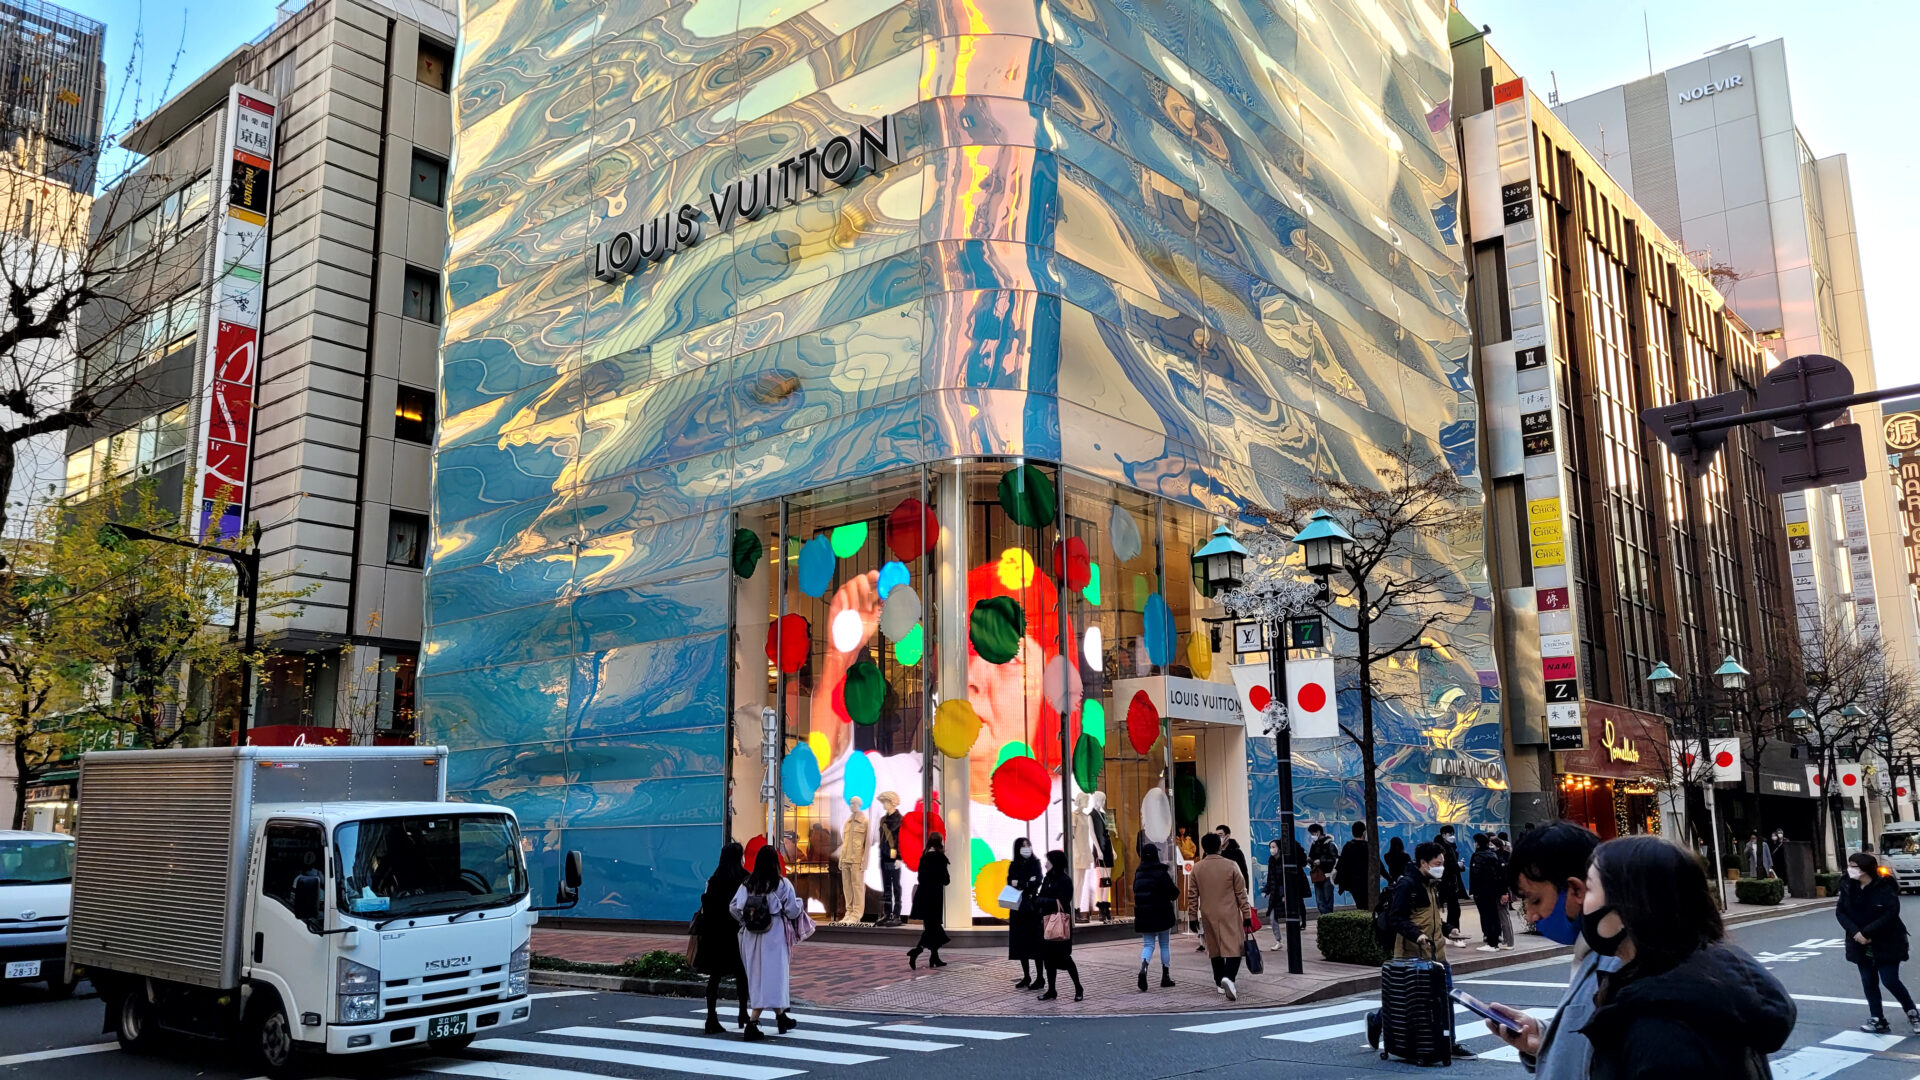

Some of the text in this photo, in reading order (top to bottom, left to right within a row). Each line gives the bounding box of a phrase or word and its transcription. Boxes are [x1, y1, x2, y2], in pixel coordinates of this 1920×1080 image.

[1678, 74, 1743, 104] NOEVIR
[240, 129, 268, 148] 京屋
[594, 114, 900, 282] LOUIS VUITTON
[1887, 419, 1918, 445] 源
[1531, 504, 1557, 515] CHICK
[1533, 526, 1559, 537] CHICK
[1535, 548, 1561, 559] CHICK
[1301, 625, 1313, 640] 7
[1555, 684, 1568, 698] Z
[1170, 690, 1242, 712] LOUIS VUITTON
[1602, 718, 1640, 763] Pomellato
[1441, 759, 1466, 776] LOUIS
[12, 967, 38, 976] 28-33
[425, 956, 472, 971] ISUZU
[437, 1021, 466, 1037] 58-67
